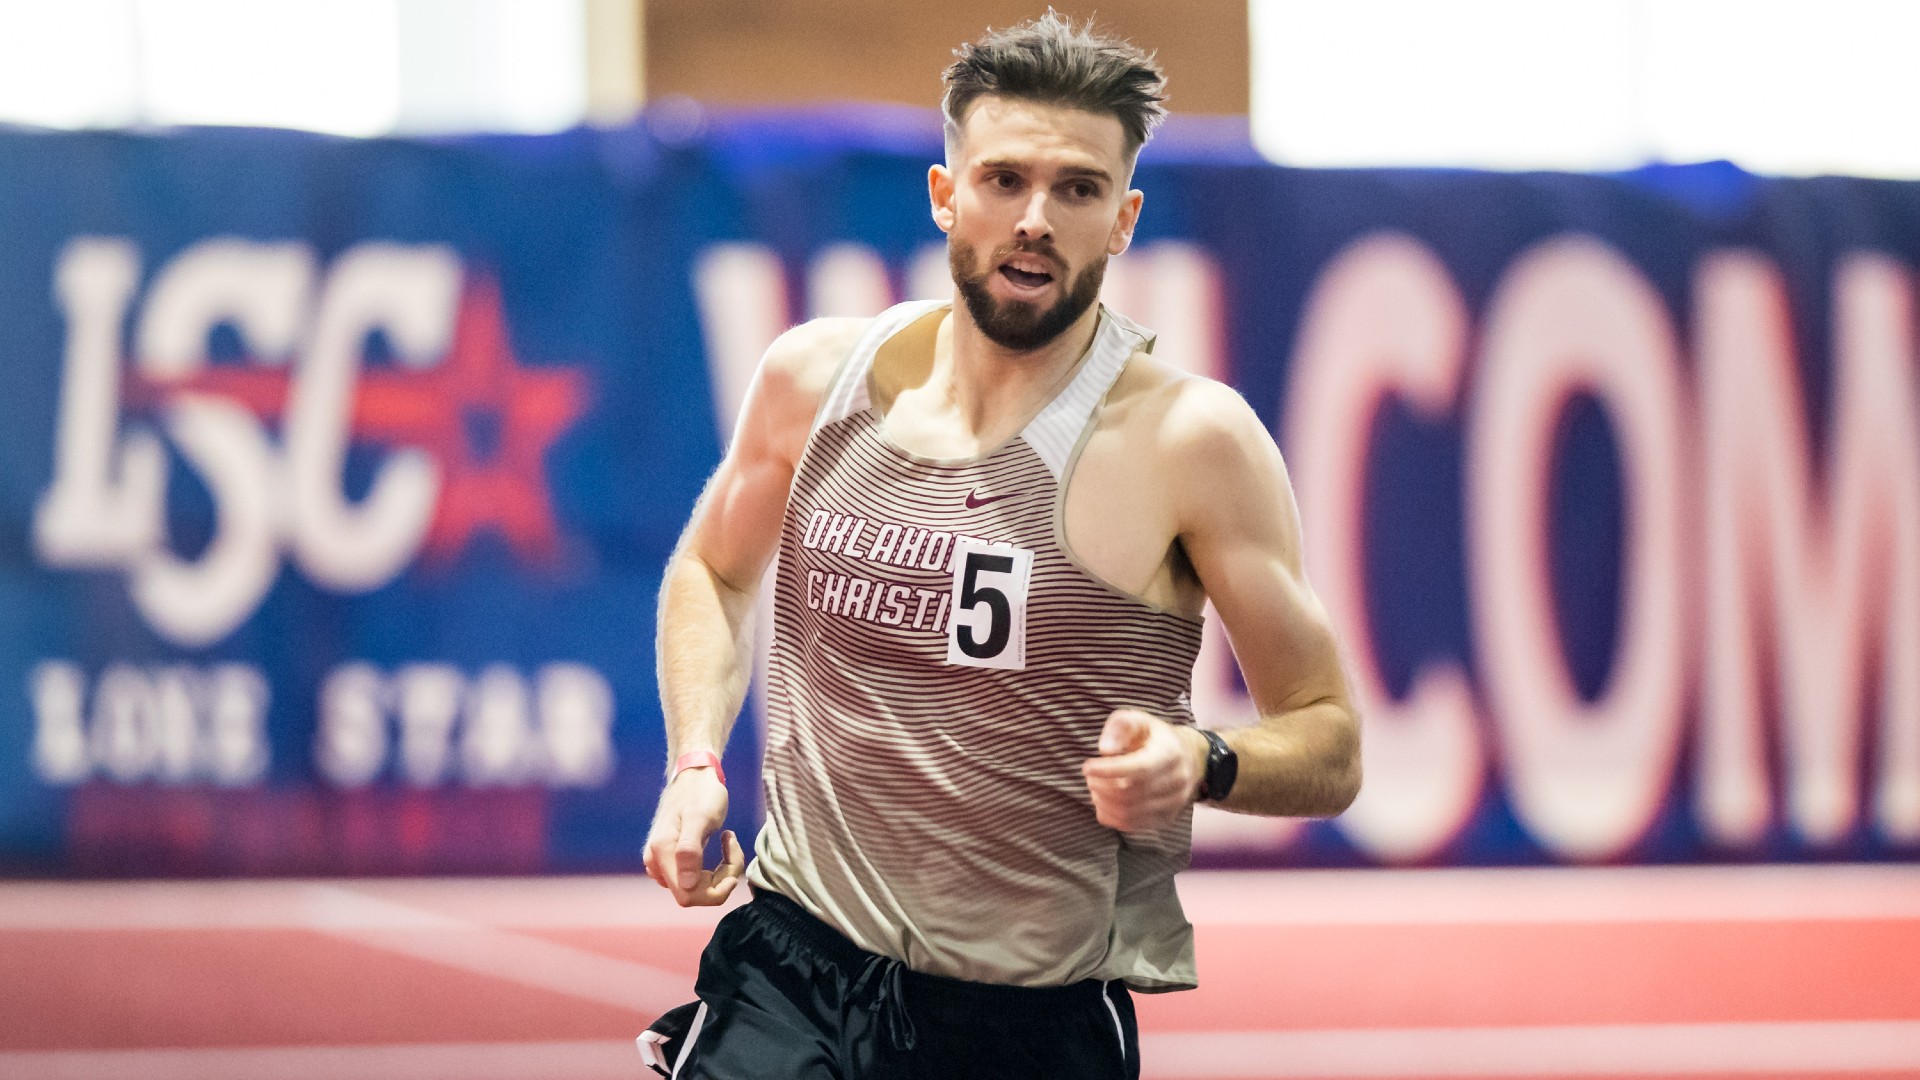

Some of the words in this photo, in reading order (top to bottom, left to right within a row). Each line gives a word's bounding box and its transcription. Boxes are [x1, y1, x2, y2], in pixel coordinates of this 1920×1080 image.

[34, 238, 464, 646] LSC
[803, 508, 1013, 574] OKLAHO
[807, 568, 952, 635] CHRISTI
[957, 552, 1014, 659] 5
[318, 661, 615, 787] STAR
